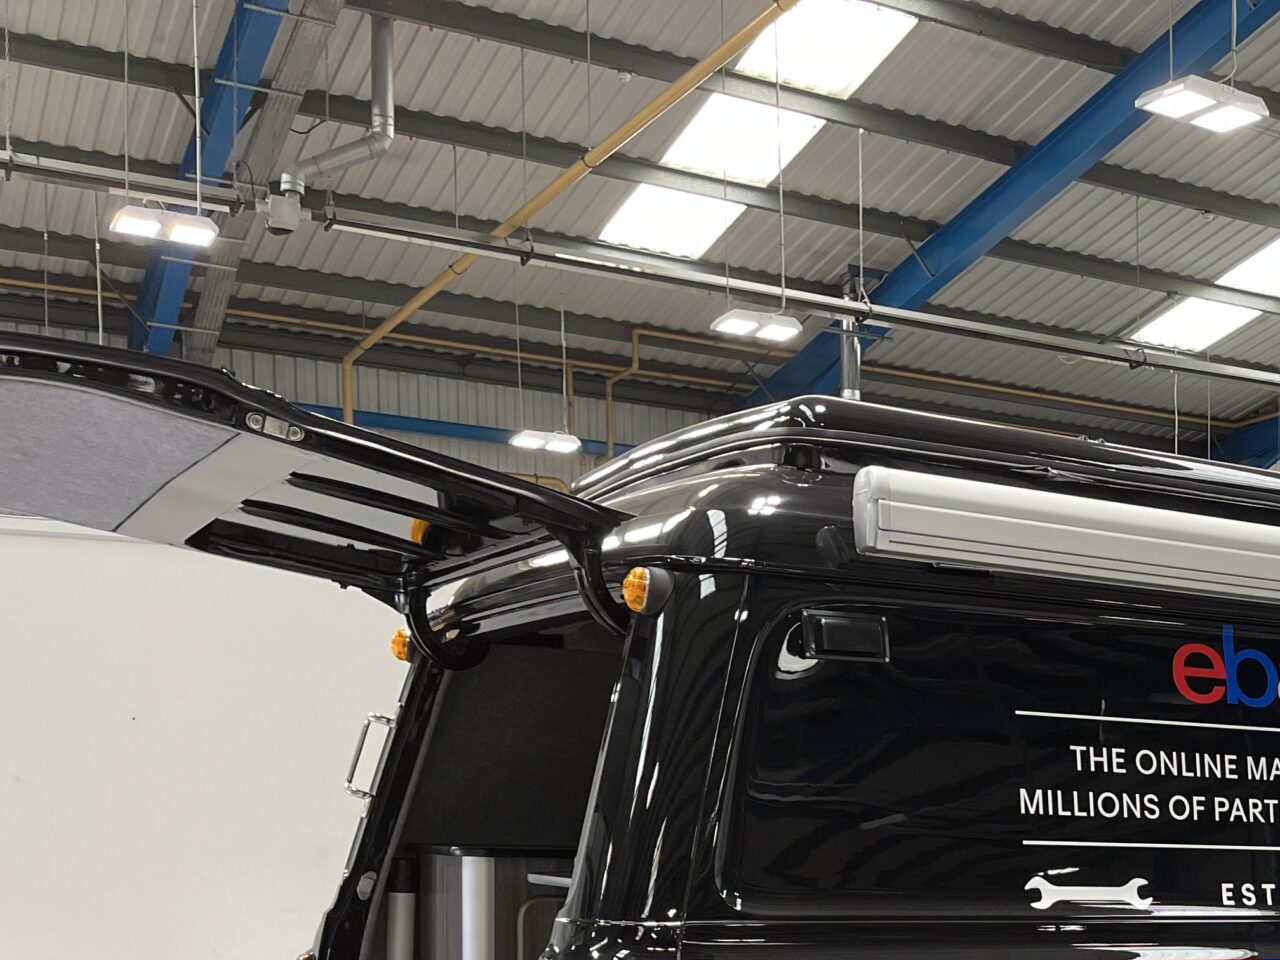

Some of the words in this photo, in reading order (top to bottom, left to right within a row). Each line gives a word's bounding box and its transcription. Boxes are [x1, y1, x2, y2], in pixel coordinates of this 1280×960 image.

[1070, 746, 1127, 773] THE
[1135, 750, 1239, 779] ONLINE
[1019, 789, 1160, 819] MILLIONS
[1169, 795, 1206, 821] OF
